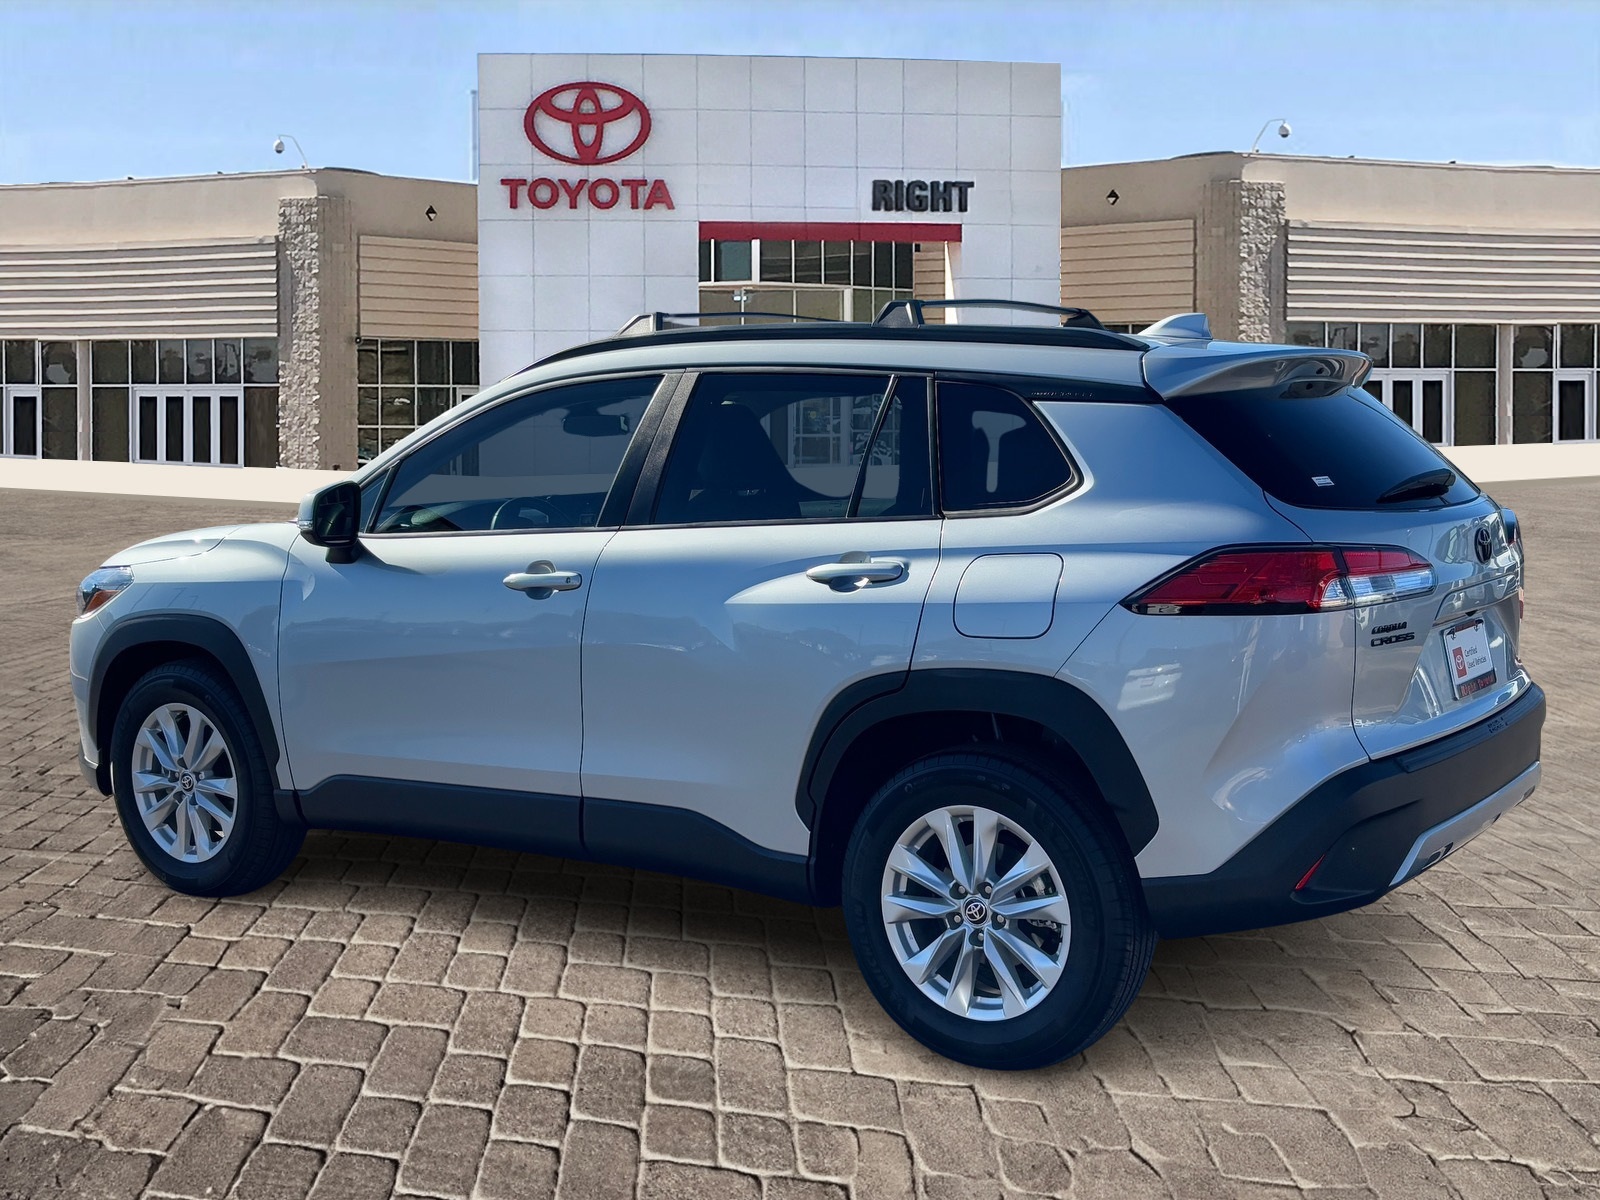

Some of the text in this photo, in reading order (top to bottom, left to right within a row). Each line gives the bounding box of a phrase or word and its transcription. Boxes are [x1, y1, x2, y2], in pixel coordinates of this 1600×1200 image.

[500, 178, 675, 210] TOYOTA
[872, 179, 975, 212] RIGHT
[1370, 632, 1415, 647] CROSS
